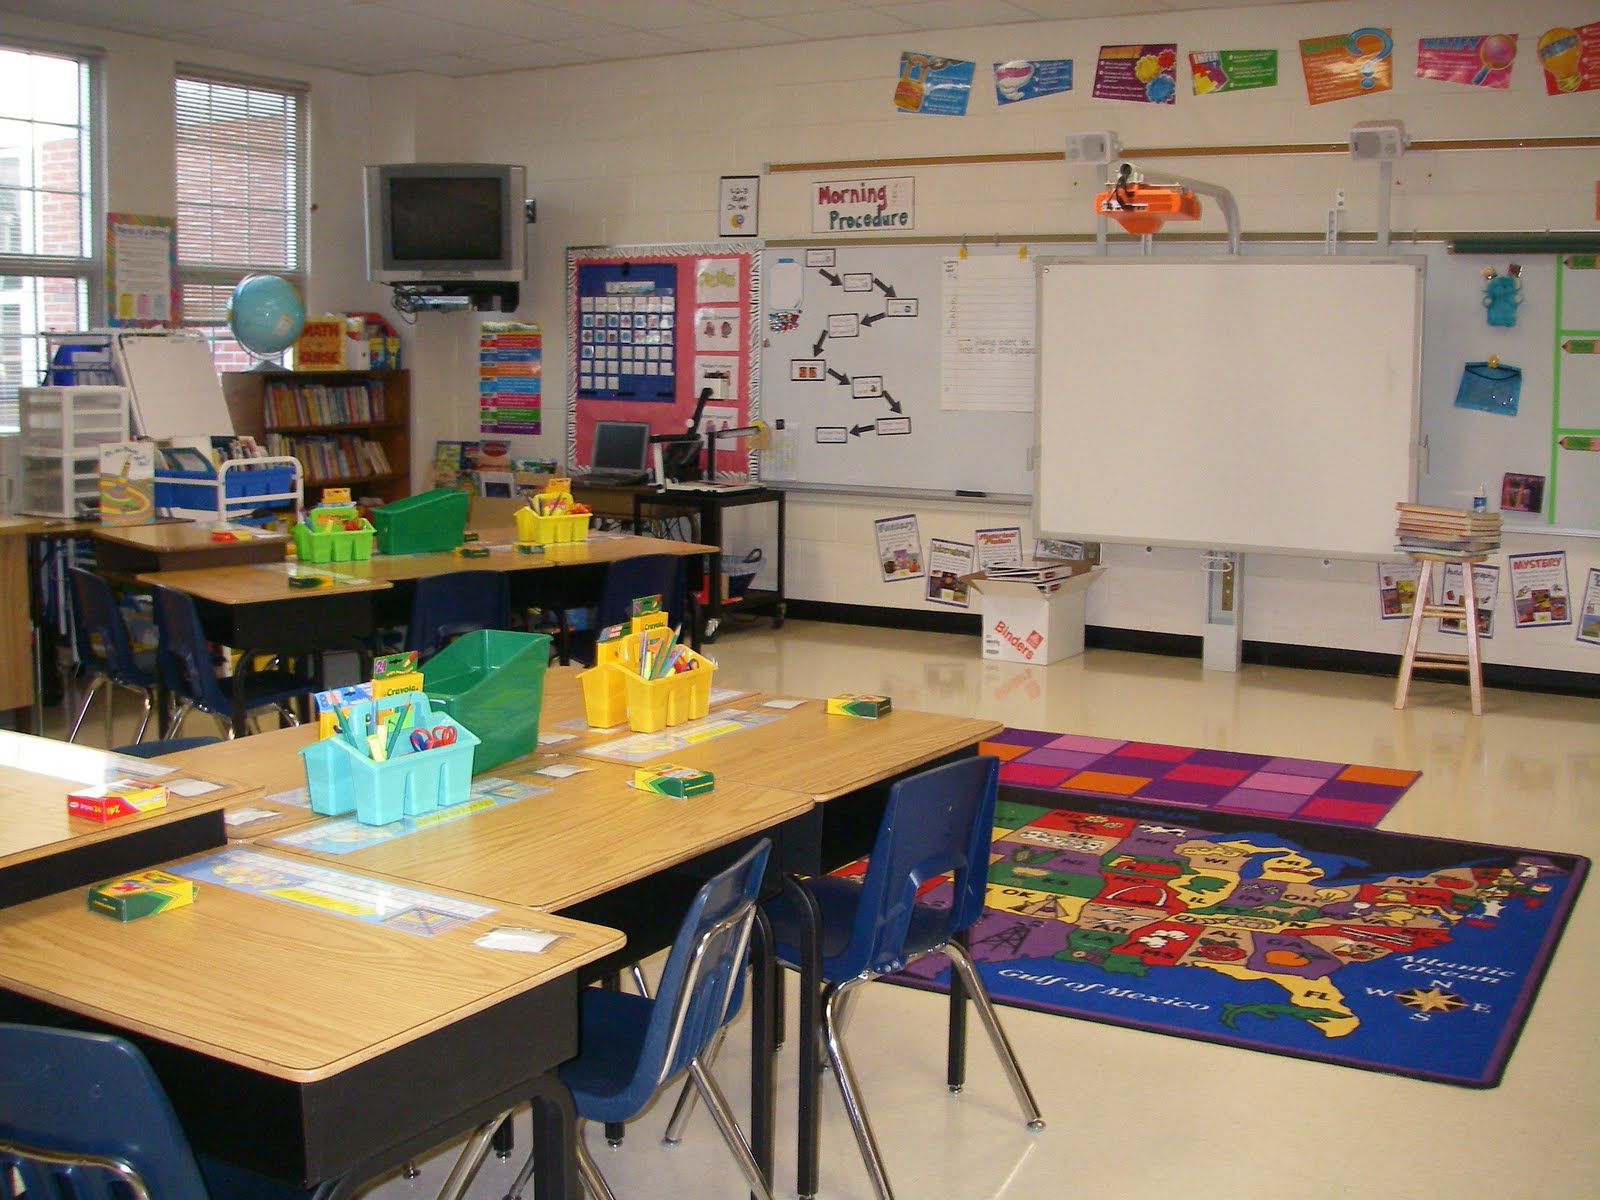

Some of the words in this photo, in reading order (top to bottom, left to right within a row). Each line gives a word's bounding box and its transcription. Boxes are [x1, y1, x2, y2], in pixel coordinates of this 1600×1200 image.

[818, 182, 888, 212] Morning
[829, 208, 909, 230] Procedure
[1513, 558, 1563, 570] MYSTERY
[995, 620, 1034, 660] Binders
[386, 685, 415, 697] Crayola
[1204, 857, 1229, 865] WI
[1112, 875, 1147, 885] MO
[1396, 878, 1428, 887] NY
[1002, 888, 1036, 899] OK
[1189, 896, 1206, 905] IL
[1208, 930, 1242, 940] AL
[1266, 938, 1304, 948] GA
[1141, 948, 1175, 959] MS
[1356, 944, 1385, 954] SC
[1395, 955, 1516, 978] Atlantic
[1401, 963, 1501, 984] Ocean
[997, 968, 1068, 987] Gulf
[1064, 981, 1105, 993] of
[1100, 986, 1211, 1011] Mexico
[1429, 979, 1454, 989] N
[1303, 990, 1331, 1000] FL
[1364, 986, 1394, 997] W
[1472, 1003, 1493, 1014] E
[1409, 1012, 1433, 1022] S
